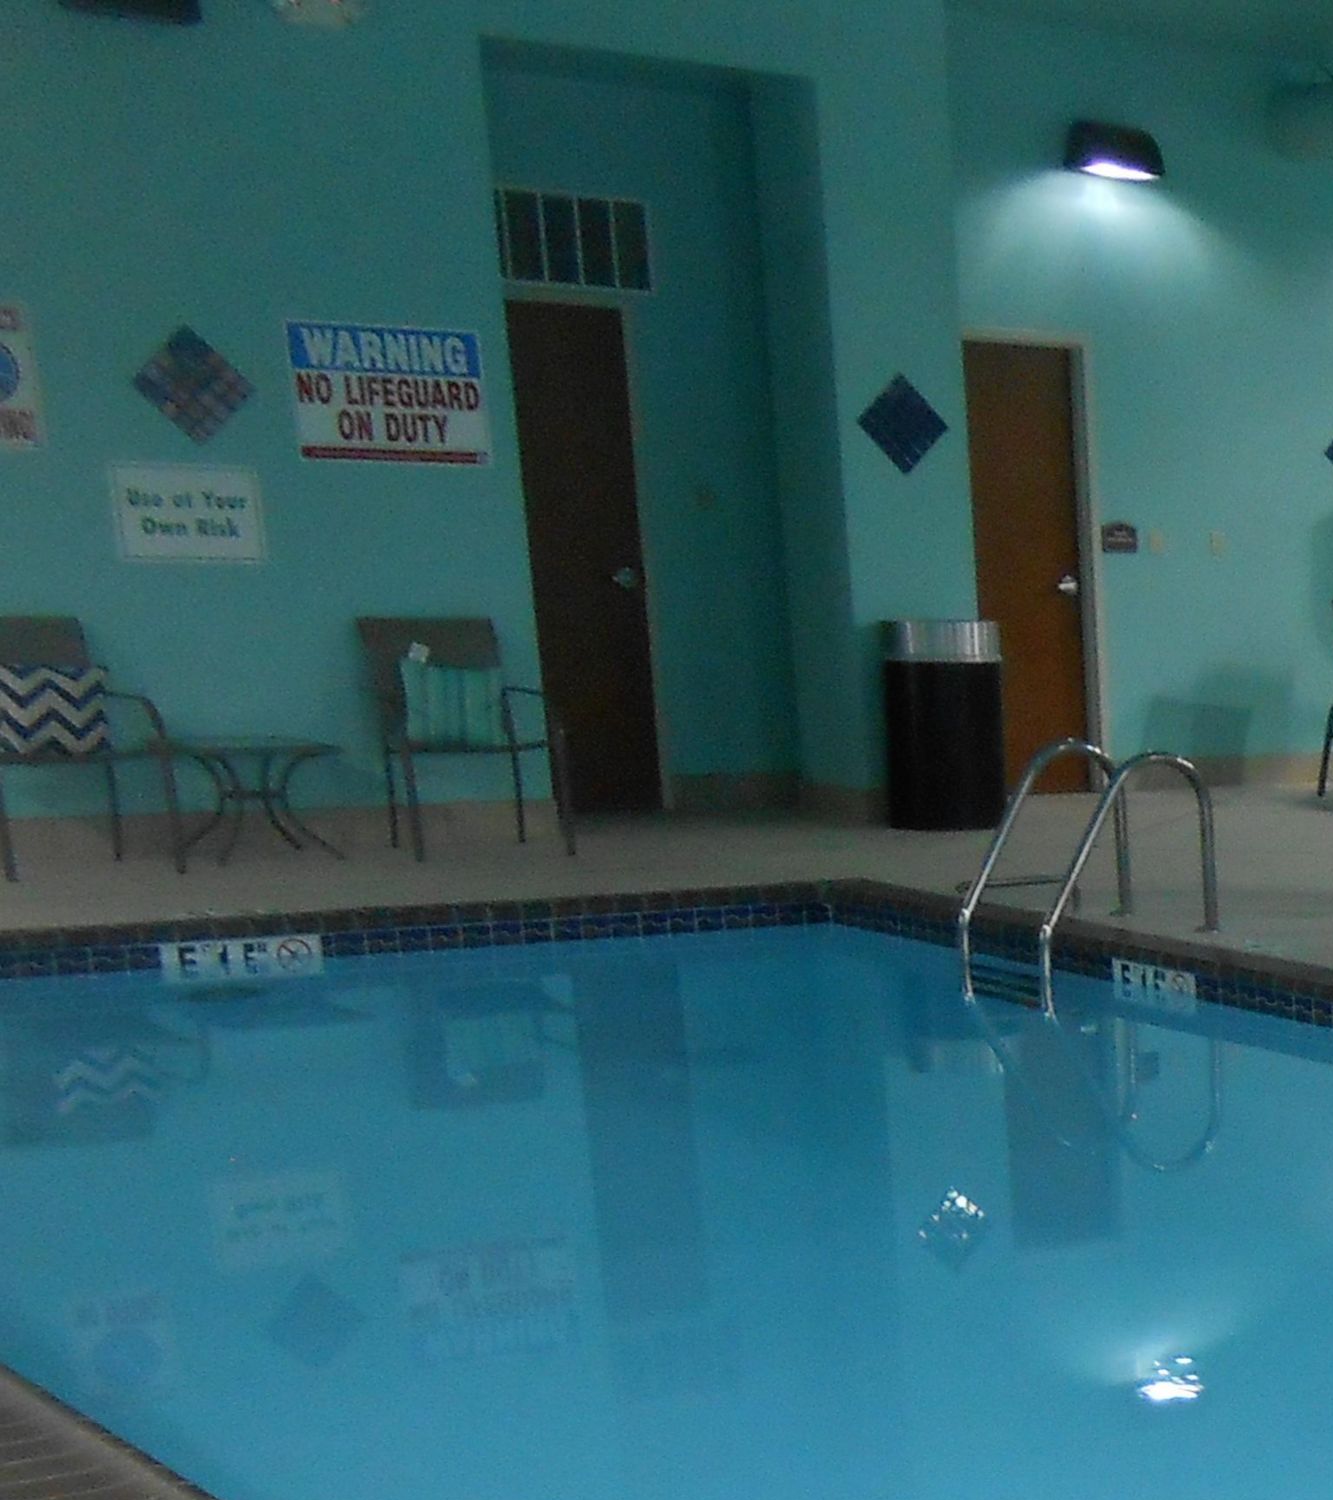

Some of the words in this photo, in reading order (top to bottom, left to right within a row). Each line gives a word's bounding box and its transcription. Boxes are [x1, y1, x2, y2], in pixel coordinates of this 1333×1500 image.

[302, 327, 469, 374] WARNING
[296, 372, 332, 404] NO
[343, 375, 480, 411] LIFEGUARD
[338, 410, 373, 441] ON
[385, 413, 448, 443] DUTY
[141, 516, 187, 535] Own
